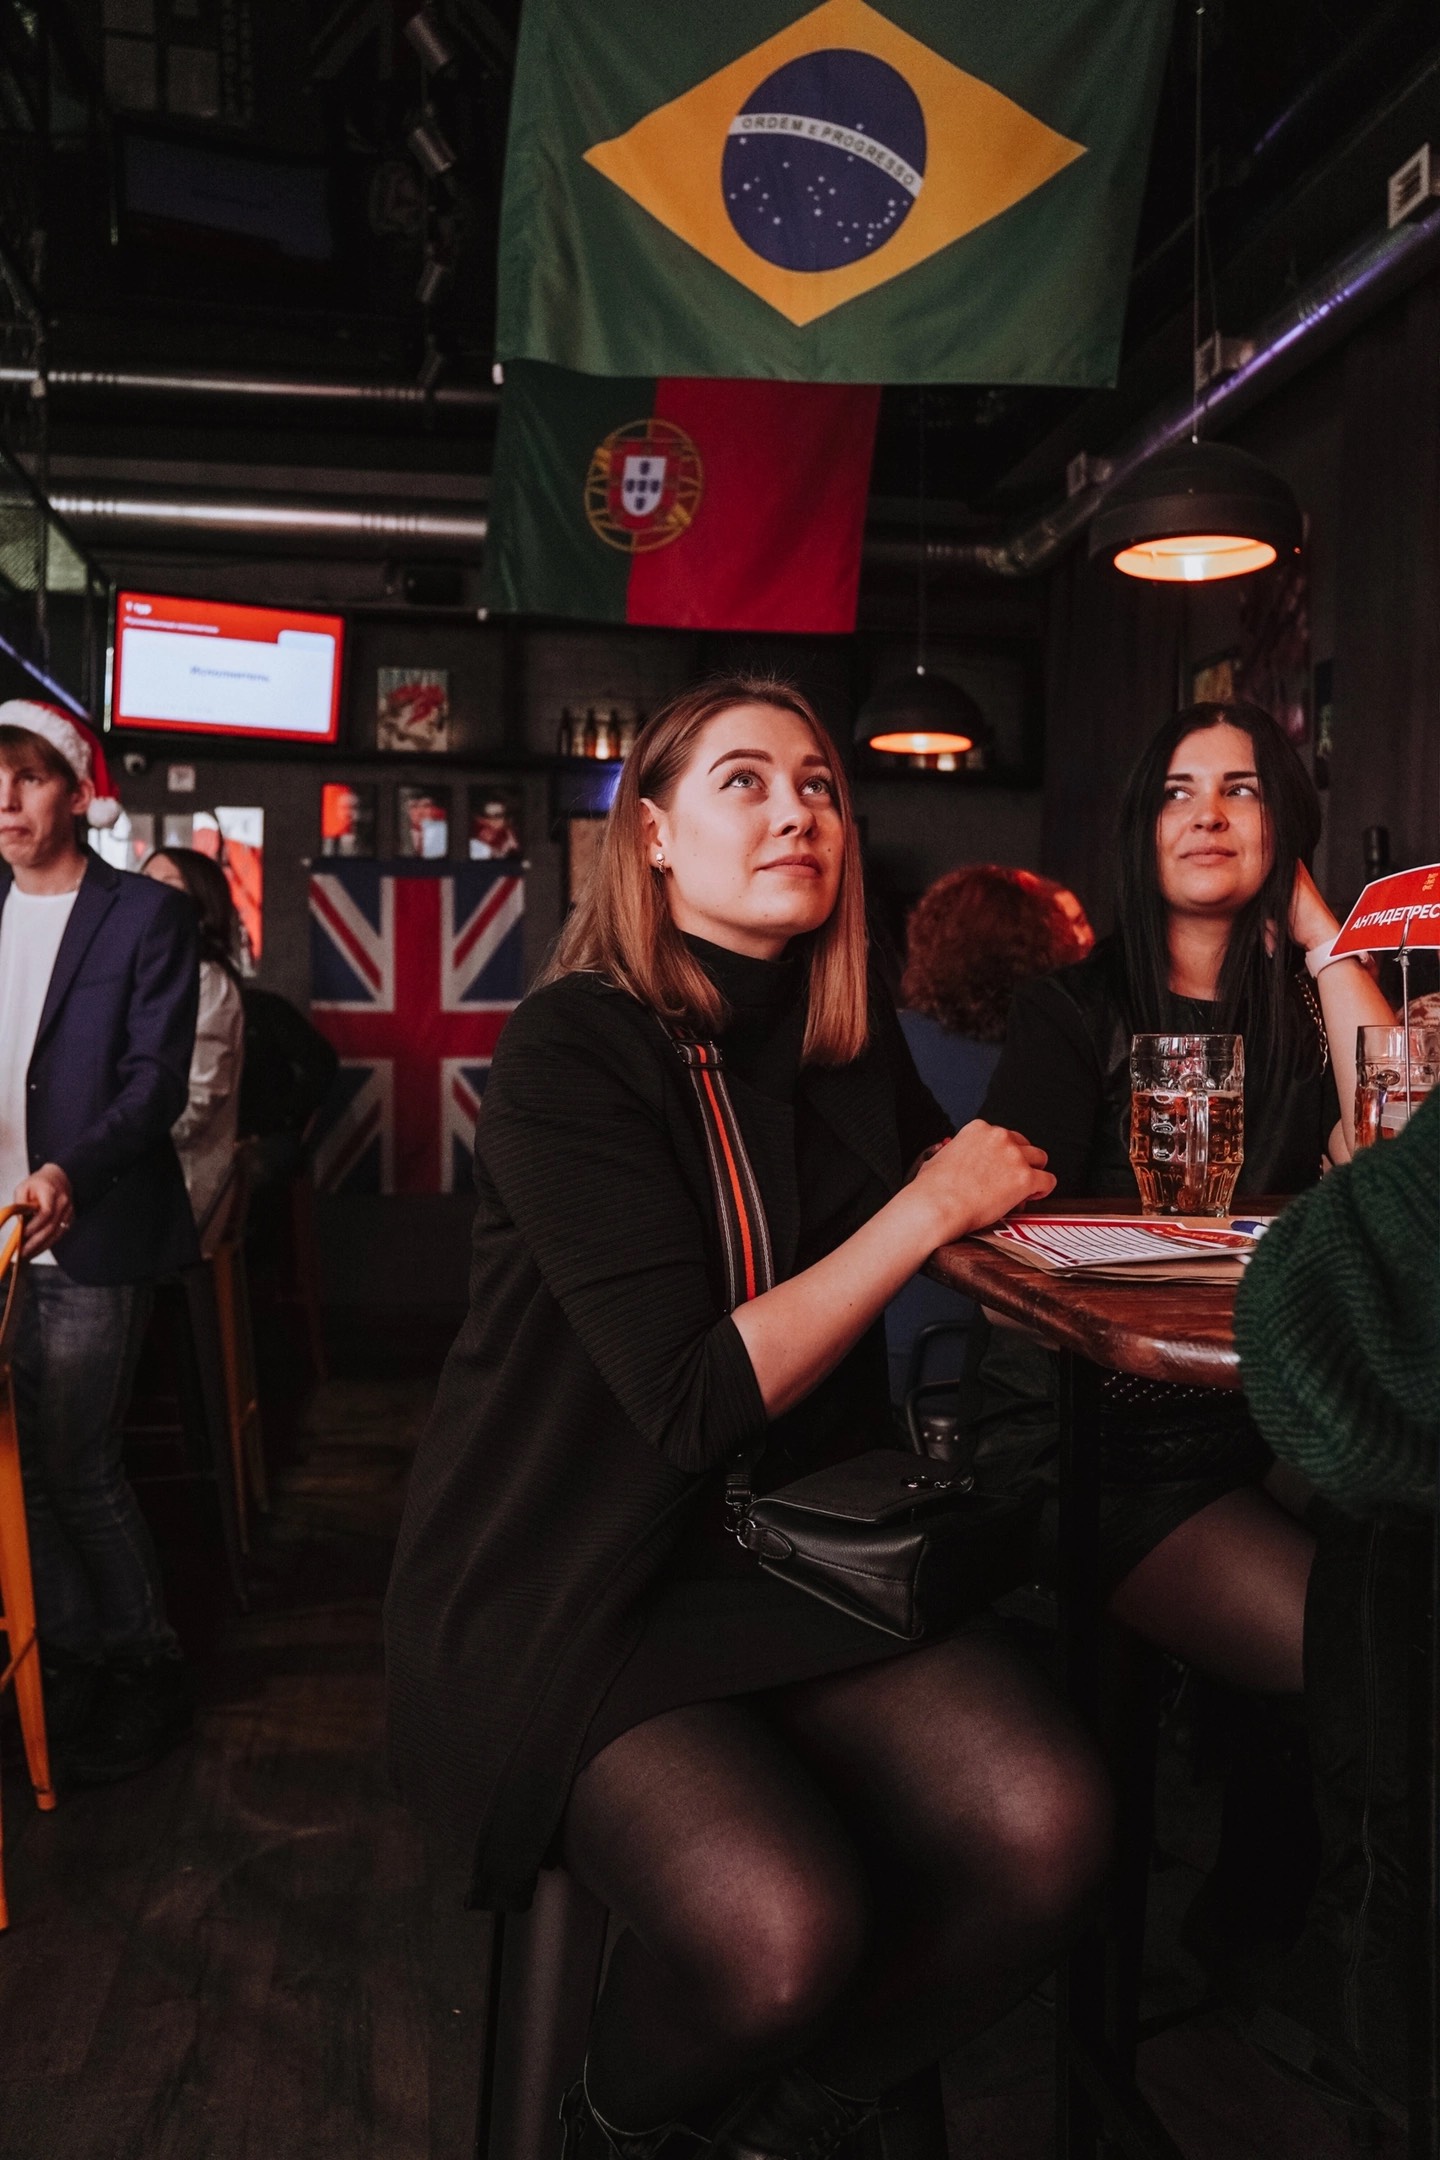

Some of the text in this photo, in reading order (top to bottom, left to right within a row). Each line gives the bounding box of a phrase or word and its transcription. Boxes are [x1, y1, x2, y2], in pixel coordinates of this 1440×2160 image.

[742, 116, 915, 186] ORDEM E PROGRESSO
[1350, 903, 1440, 931] АНТИДЕПРЕС
